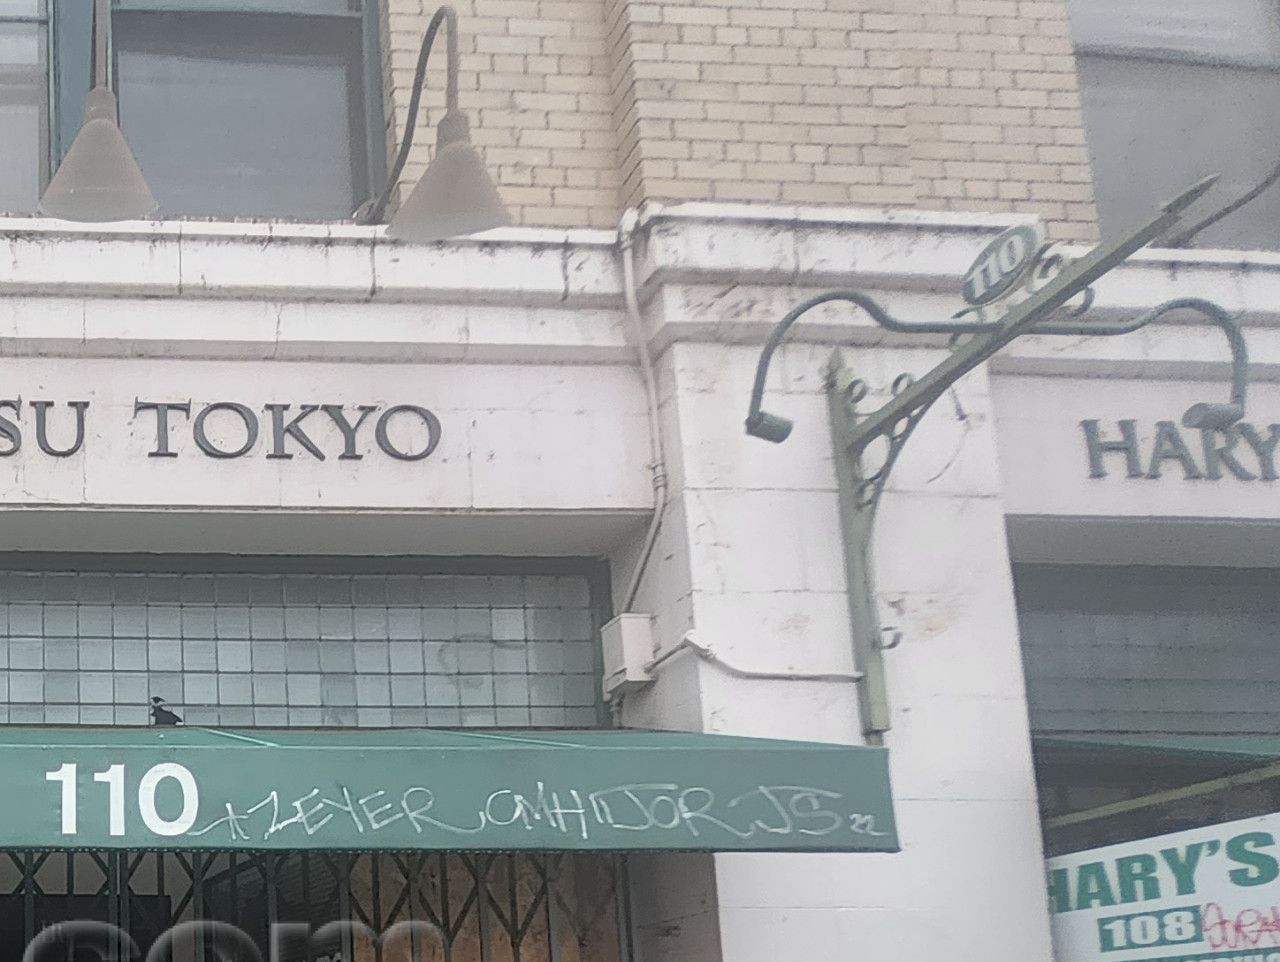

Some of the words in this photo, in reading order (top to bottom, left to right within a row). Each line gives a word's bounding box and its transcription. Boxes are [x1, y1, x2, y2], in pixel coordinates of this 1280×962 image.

[966, 235, 1024, 299] 110
[135, 397, 441, 461] TOKYO
[45, 763, 198, 836] 110
[1103, 911, 1196, 947] 108
